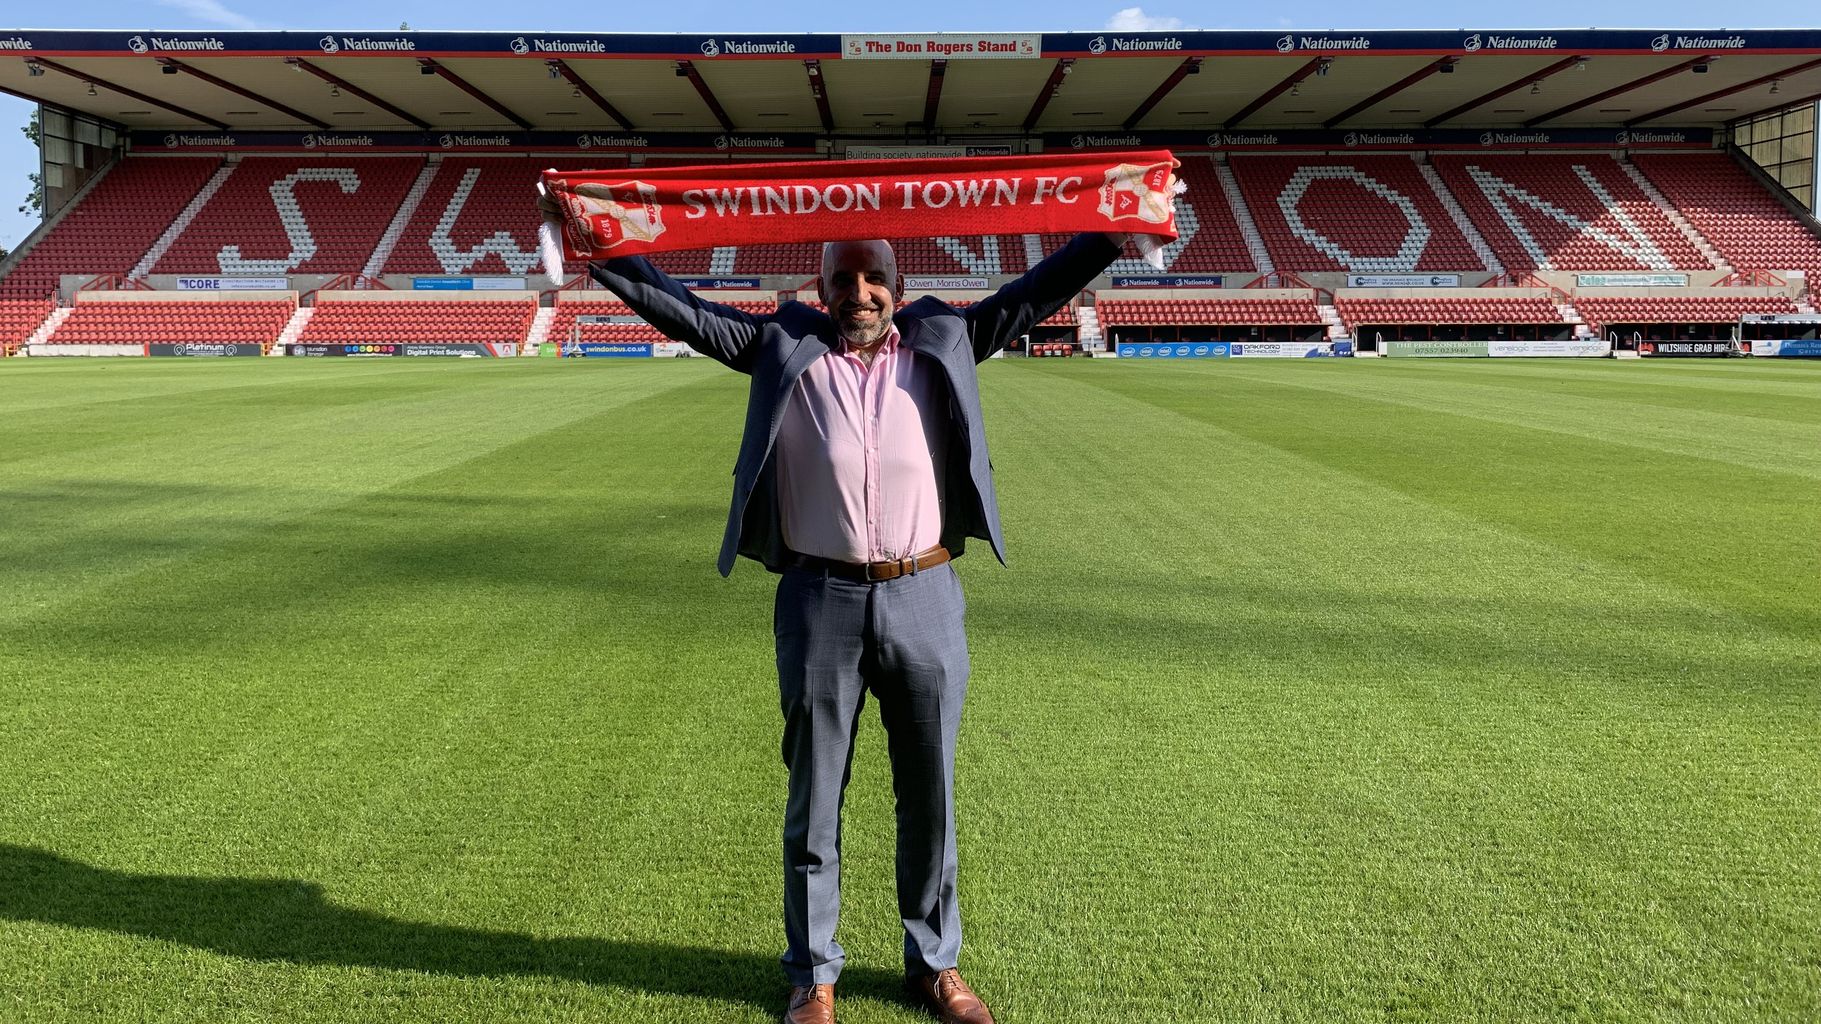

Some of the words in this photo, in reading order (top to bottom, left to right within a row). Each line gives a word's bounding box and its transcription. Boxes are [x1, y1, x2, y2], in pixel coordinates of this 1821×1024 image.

[151, 38, 224, 51] Nationwide
[342, 38, 415, 51] Nationwide
[534, 39, 606, 53] Nationwide
[724, 41, 796, 54] Nationwide
[865, 41, 891, 53] The
[896, 41, 922, 53] Don
[926, 40, 973, 55] Rogers
[977, 40, 1016, 53] Stand
[1112, 38, 1182, 51] Nationwide
[1300, 37, 1370, 50] Nationwide
[1486, 36, 1557, 50] Nationwide
[1673, 36, 1745, 49] Nationwide
[180, 135, 236, 146] Nationwide
[318, 135, 373, 146] Nationwide
[455, 135, 510, 146] Nationwide
[592, 135, 648, 147] Nationwide
[729, 136, 785, 148] Nationwide
[1086, 136, 1141, 147] Nationwide
[1223, 134, 1278, 145] Nationwide
[1359, 133, 1414, 144] Nationwide
[1495, 133, 1550, 144] Nationwide
[1631, 132, 1685, 143] Nationwide
[846, 150, 881, 160] Building
[977, 148, 1009, 156] Nationwide
[684, 182, 882, 219] SWINDON
[894, 177, 1022, 210] TOWN
[1031, 176, 1083, 205] FC
[600, 218, 613, 239] 1879
[189, 279, 220, 289] CORE
[910, 279, 933, 288] Owen
[937, 279, 961, 288] Morris
[962, 279, 985, 287] Owen
[186, 343, 224, 351] Platinum
[586, 344, 647, 353] swindonbus.co.uk
[1658, 343, 1692, 353] WILTSHIRE
[1694, 343, 1712, 353] GRAB
